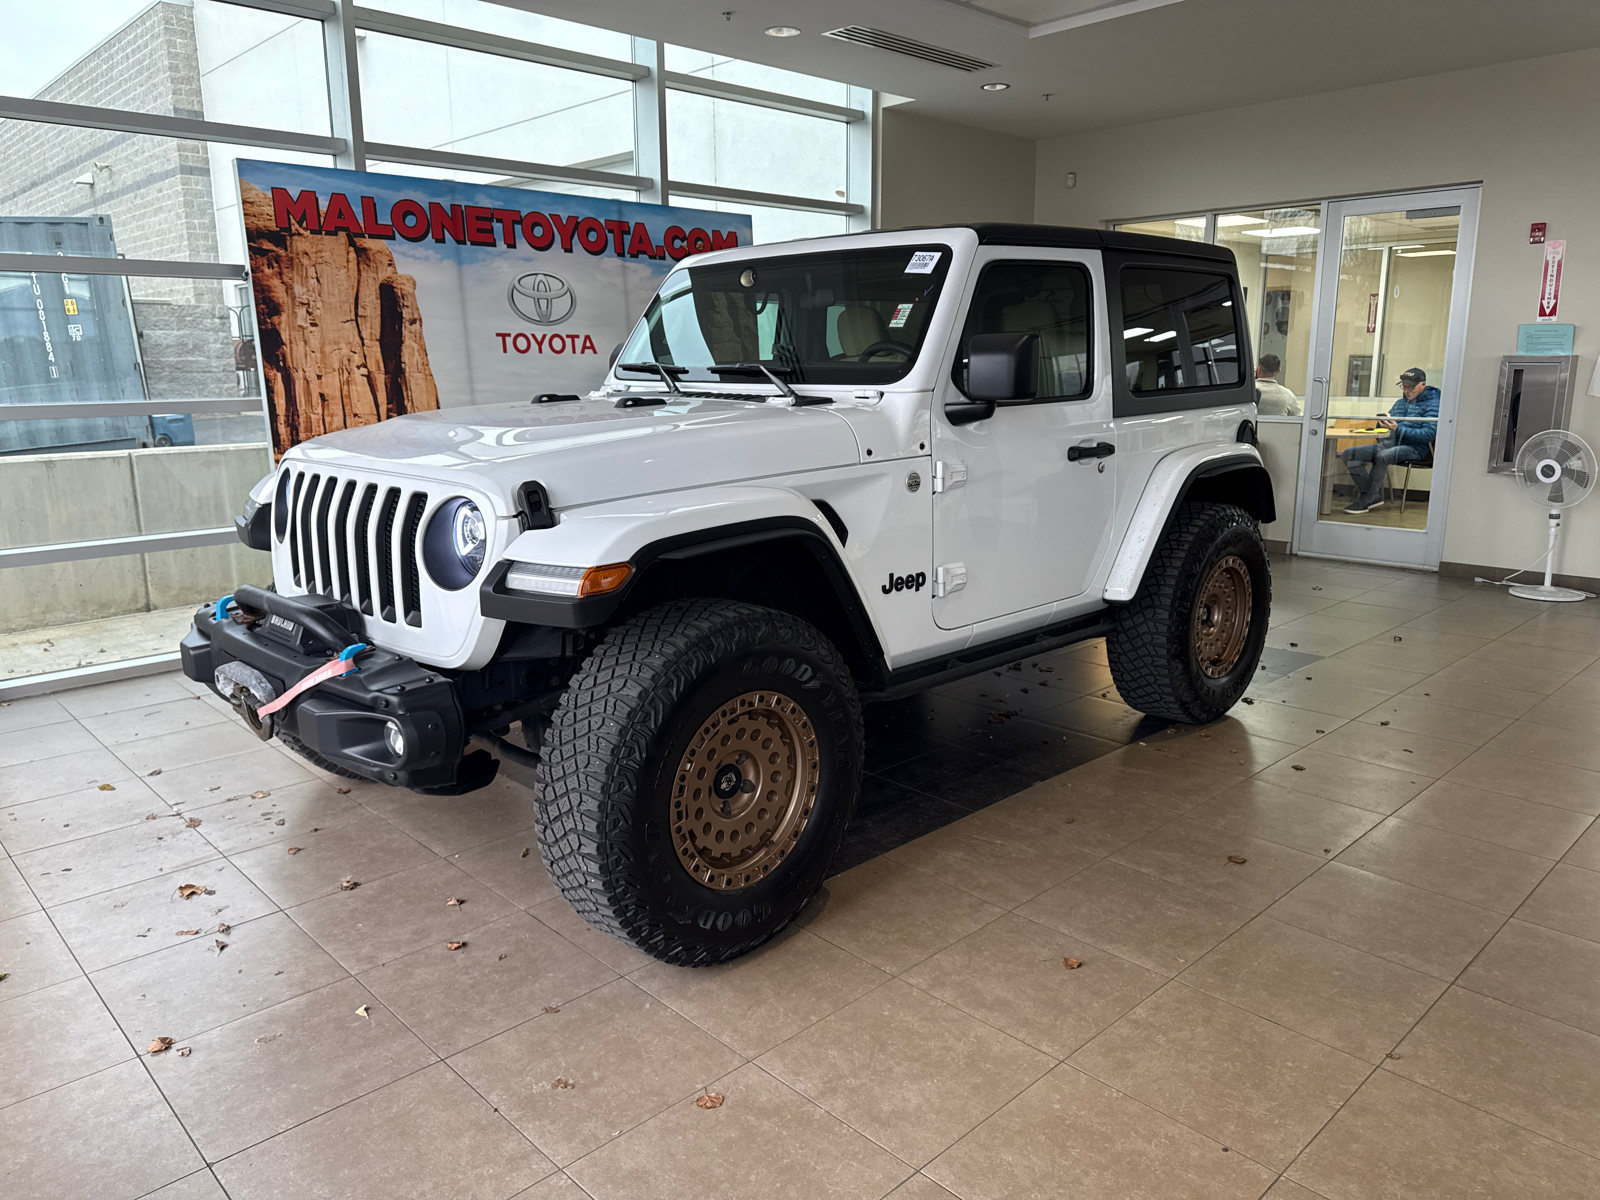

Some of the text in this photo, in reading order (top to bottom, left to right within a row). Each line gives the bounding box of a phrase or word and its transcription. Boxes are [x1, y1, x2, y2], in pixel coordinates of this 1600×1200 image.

[271, 187, 736, 260] MALONETOYOTA.COM
[1546, 256, 1556, 309] EXTINGUISHER
[496, 332, 598, 355] TOYOTA
[881, 571, 927, 595] Jeep
